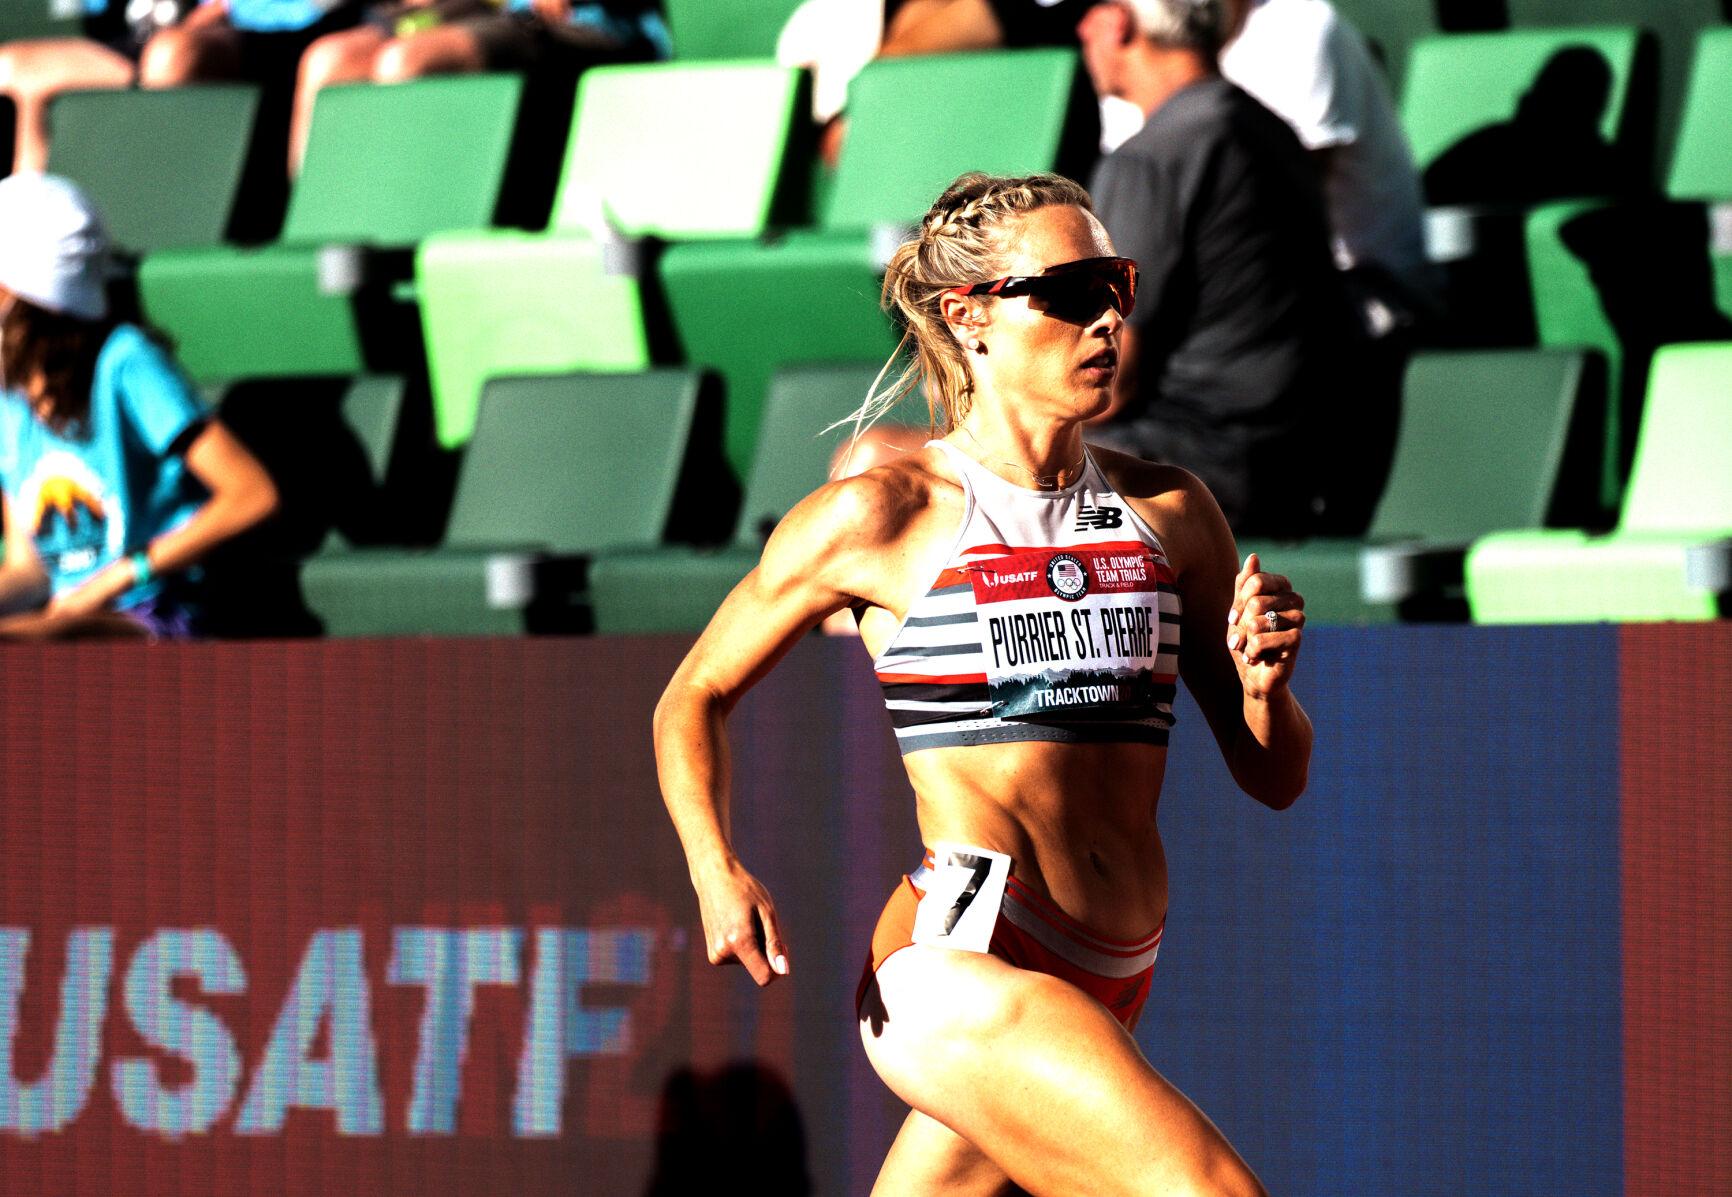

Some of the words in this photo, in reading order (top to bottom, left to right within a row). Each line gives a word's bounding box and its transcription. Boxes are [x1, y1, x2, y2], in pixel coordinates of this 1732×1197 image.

[1093, 557, 1110, 570] U.S.
[1110, 555, 1145, 570] OLYMPIC
[1000, 571, 1038, 584] USATF
[1096, 570, 1119, 583] TEAM
[1119, 568, 1147, 581] TRIALS
[989, 610, 1071, 669] PURRIER
[1071, 608, 1100, 660] ST.
[1100, 606, 1153, 658] PIERRE
[1036, 685, 1119, 708] TRACKTOWN
[936, 852, 993, 936] 7
[0, 926, 656, 1140] USATF
